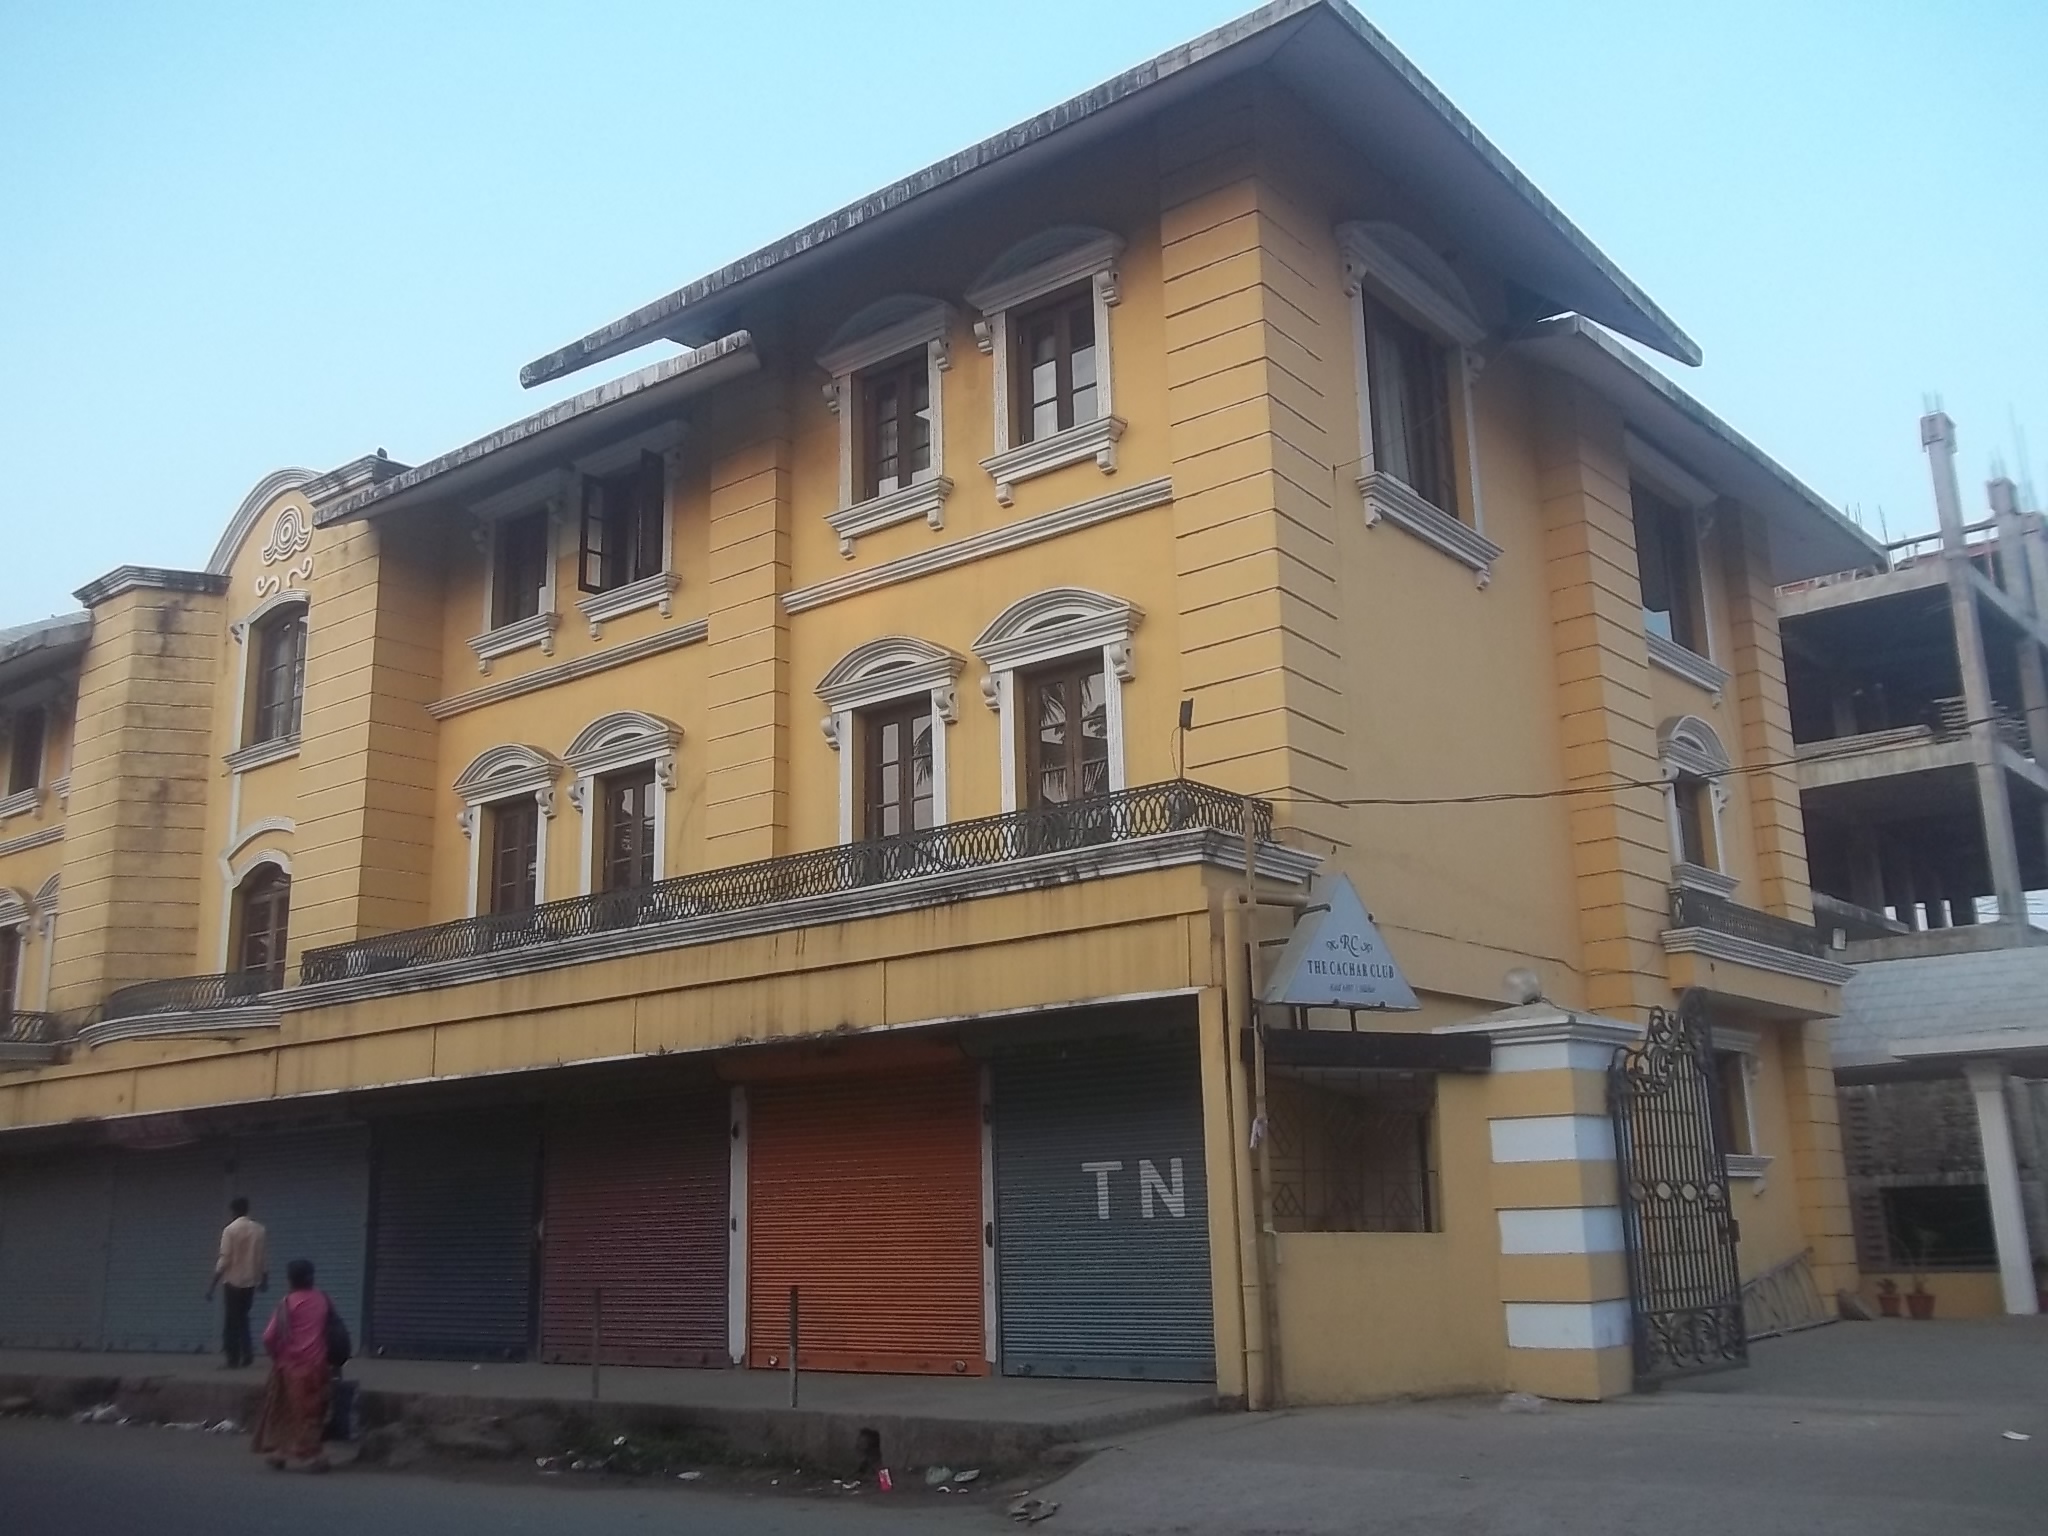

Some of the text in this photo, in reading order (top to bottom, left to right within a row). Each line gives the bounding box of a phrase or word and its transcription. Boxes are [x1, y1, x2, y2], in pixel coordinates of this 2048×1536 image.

[1307, 960, 1395, 979] THE CACHAR CLUB
